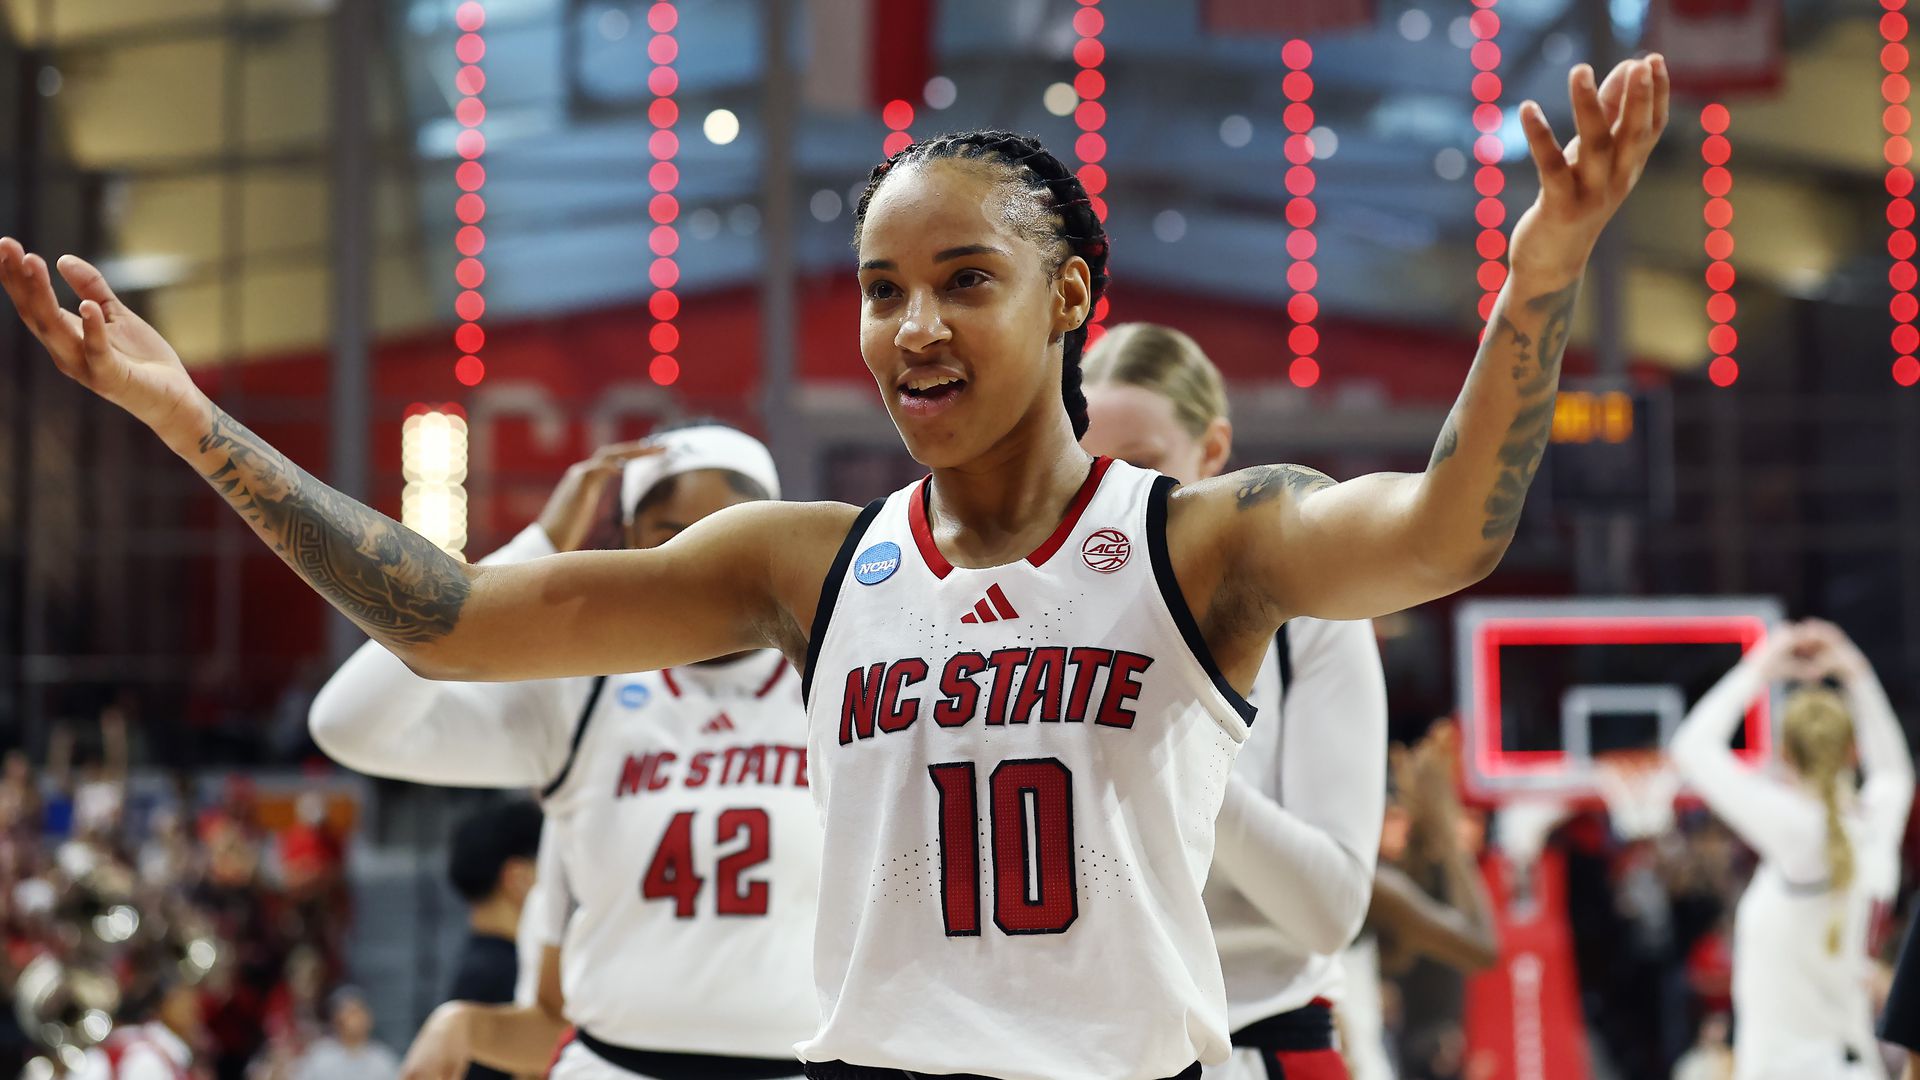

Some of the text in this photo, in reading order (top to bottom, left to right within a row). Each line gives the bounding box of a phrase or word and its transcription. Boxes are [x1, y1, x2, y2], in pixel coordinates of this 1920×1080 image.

[858, 557, 898, 575] NCAA
[1087, 542, 1129, 554] ACC
[839, 646, 1155, 746] NC STATE
[614, 751, 677, 798] NC
[641, 807, 770, 919] 42
[928, 757, 1079, 937] 10
